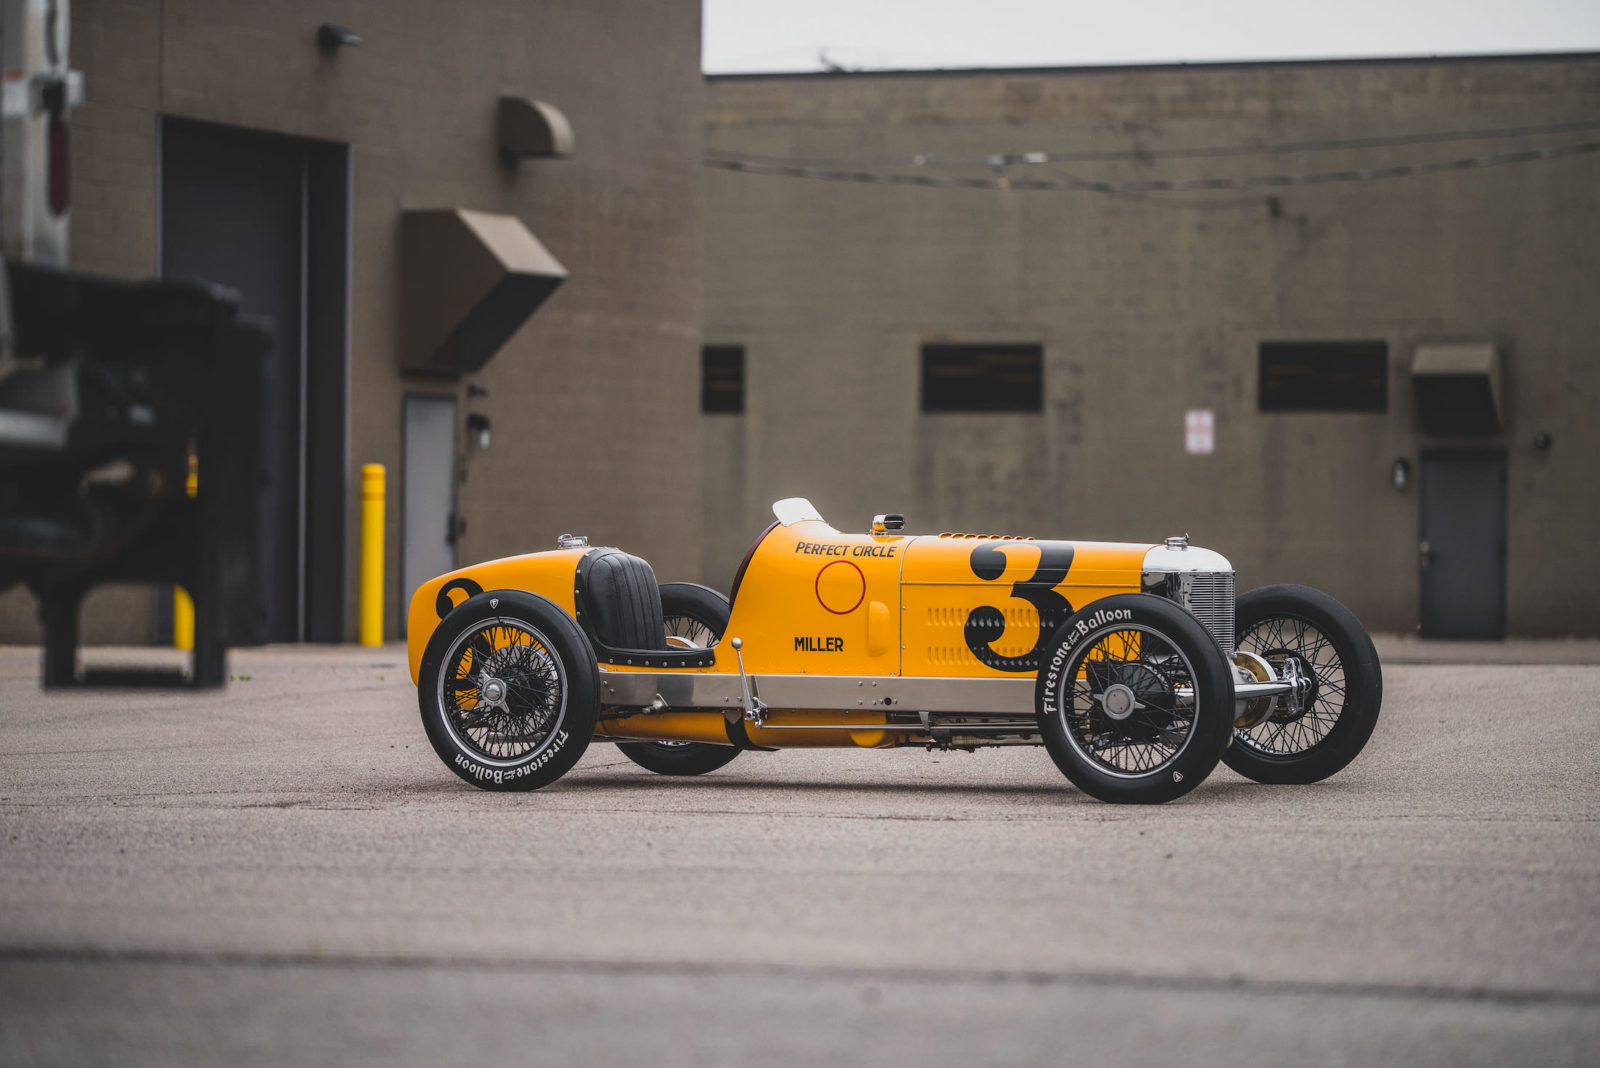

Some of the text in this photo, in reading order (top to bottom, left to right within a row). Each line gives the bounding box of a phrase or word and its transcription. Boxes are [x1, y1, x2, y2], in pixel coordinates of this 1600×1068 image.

[795, 541, 897, 558] PERFECT CIRCLE
[964, 541, 1075, 673] 3
[794, 636, 844, 652] MILLER
[1042, 609, 1132, 715] Firestone Balloon
[454, 729, 569, 784] Firestone Balloon
